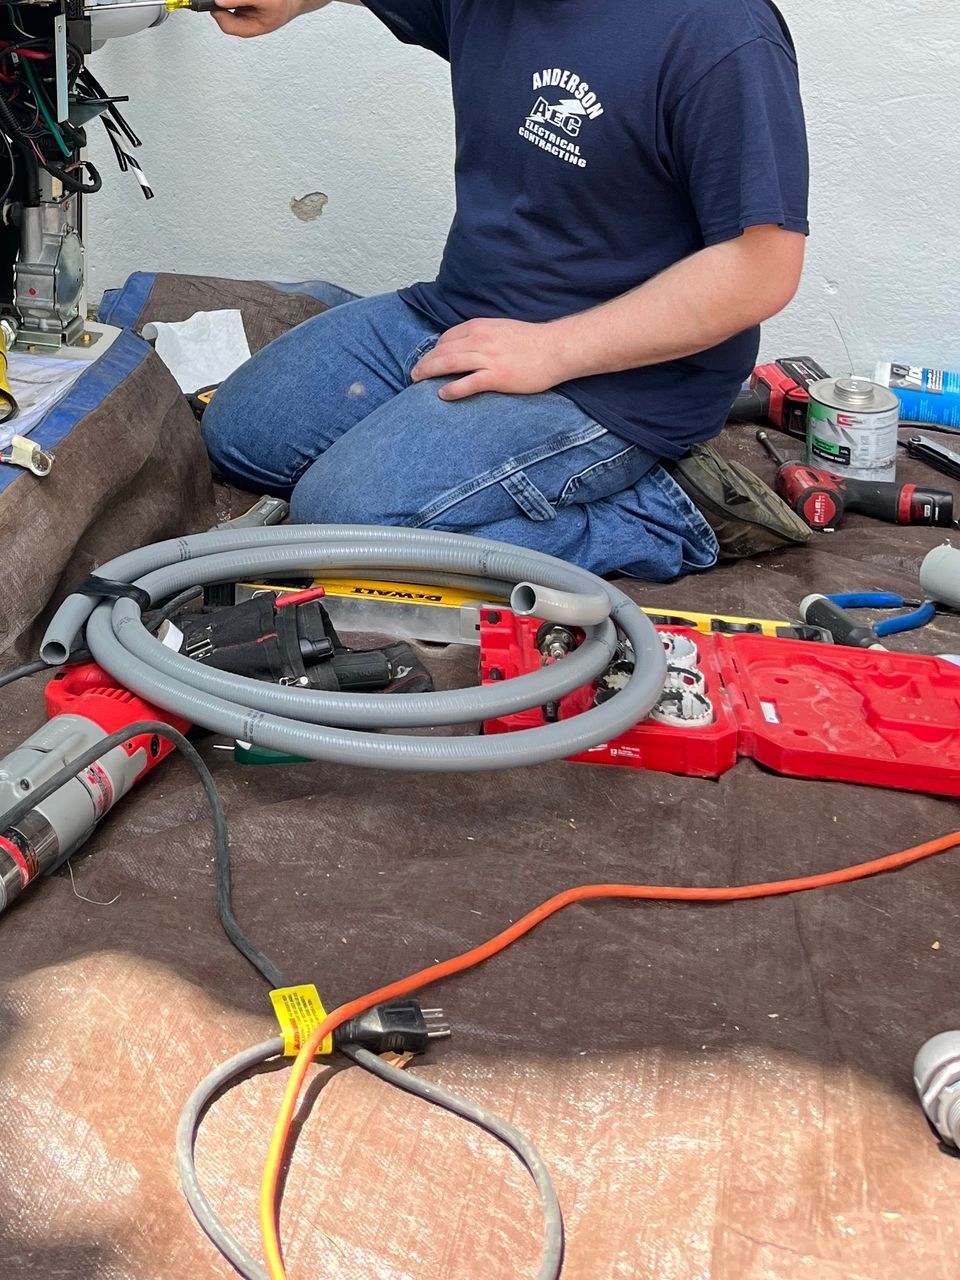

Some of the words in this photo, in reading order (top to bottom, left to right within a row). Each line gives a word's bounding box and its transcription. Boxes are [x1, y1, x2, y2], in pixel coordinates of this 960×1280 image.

[532, 68, 604, 120] ANDERSON
[518, 126, 587, 168] CONTRACTING
[524, 119, 581, 156] ELECTRICAL
[351, 587, 443, 602] DEWALT
